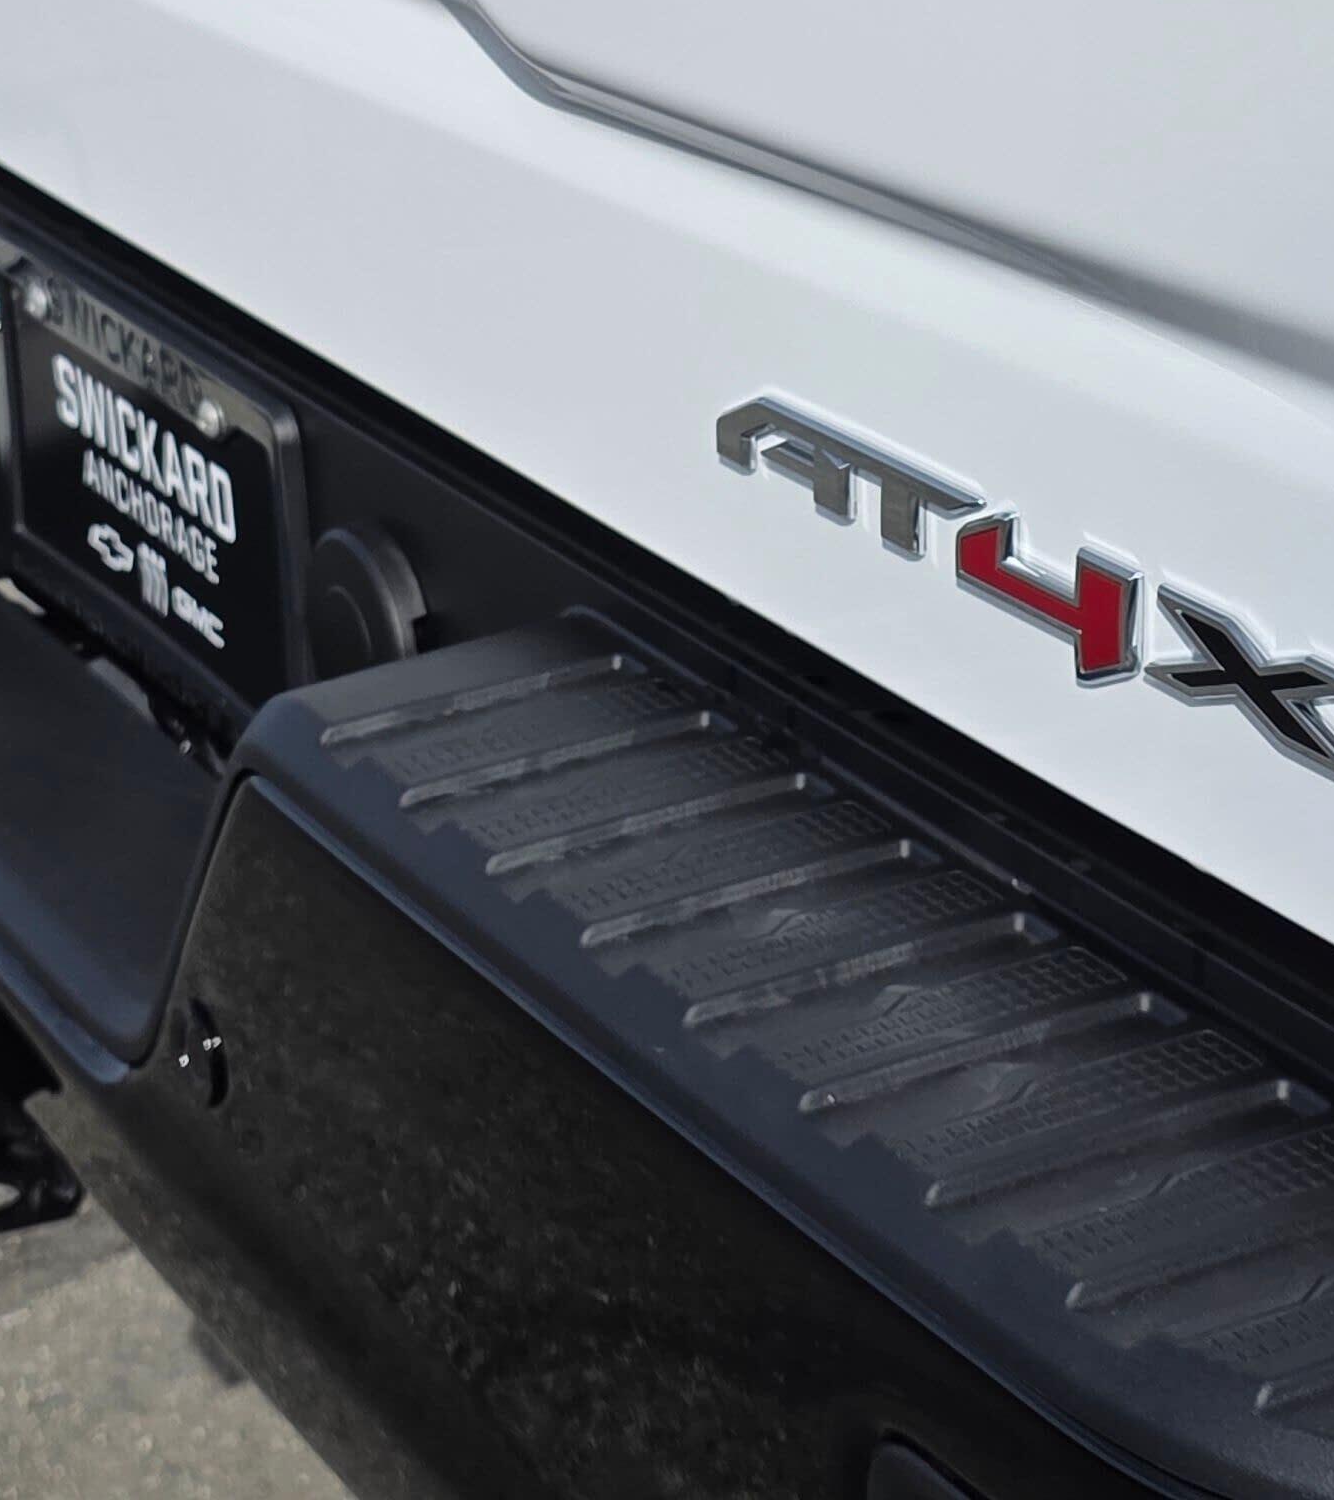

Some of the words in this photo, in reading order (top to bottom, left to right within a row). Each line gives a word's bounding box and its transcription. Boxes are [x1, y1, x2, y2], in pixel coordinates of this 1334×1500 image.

[51, 353, 237, 544] SWICKARD
[82, 449, 220, 585] ANCHORAGE
[171, 586, 226, 650] GMC
